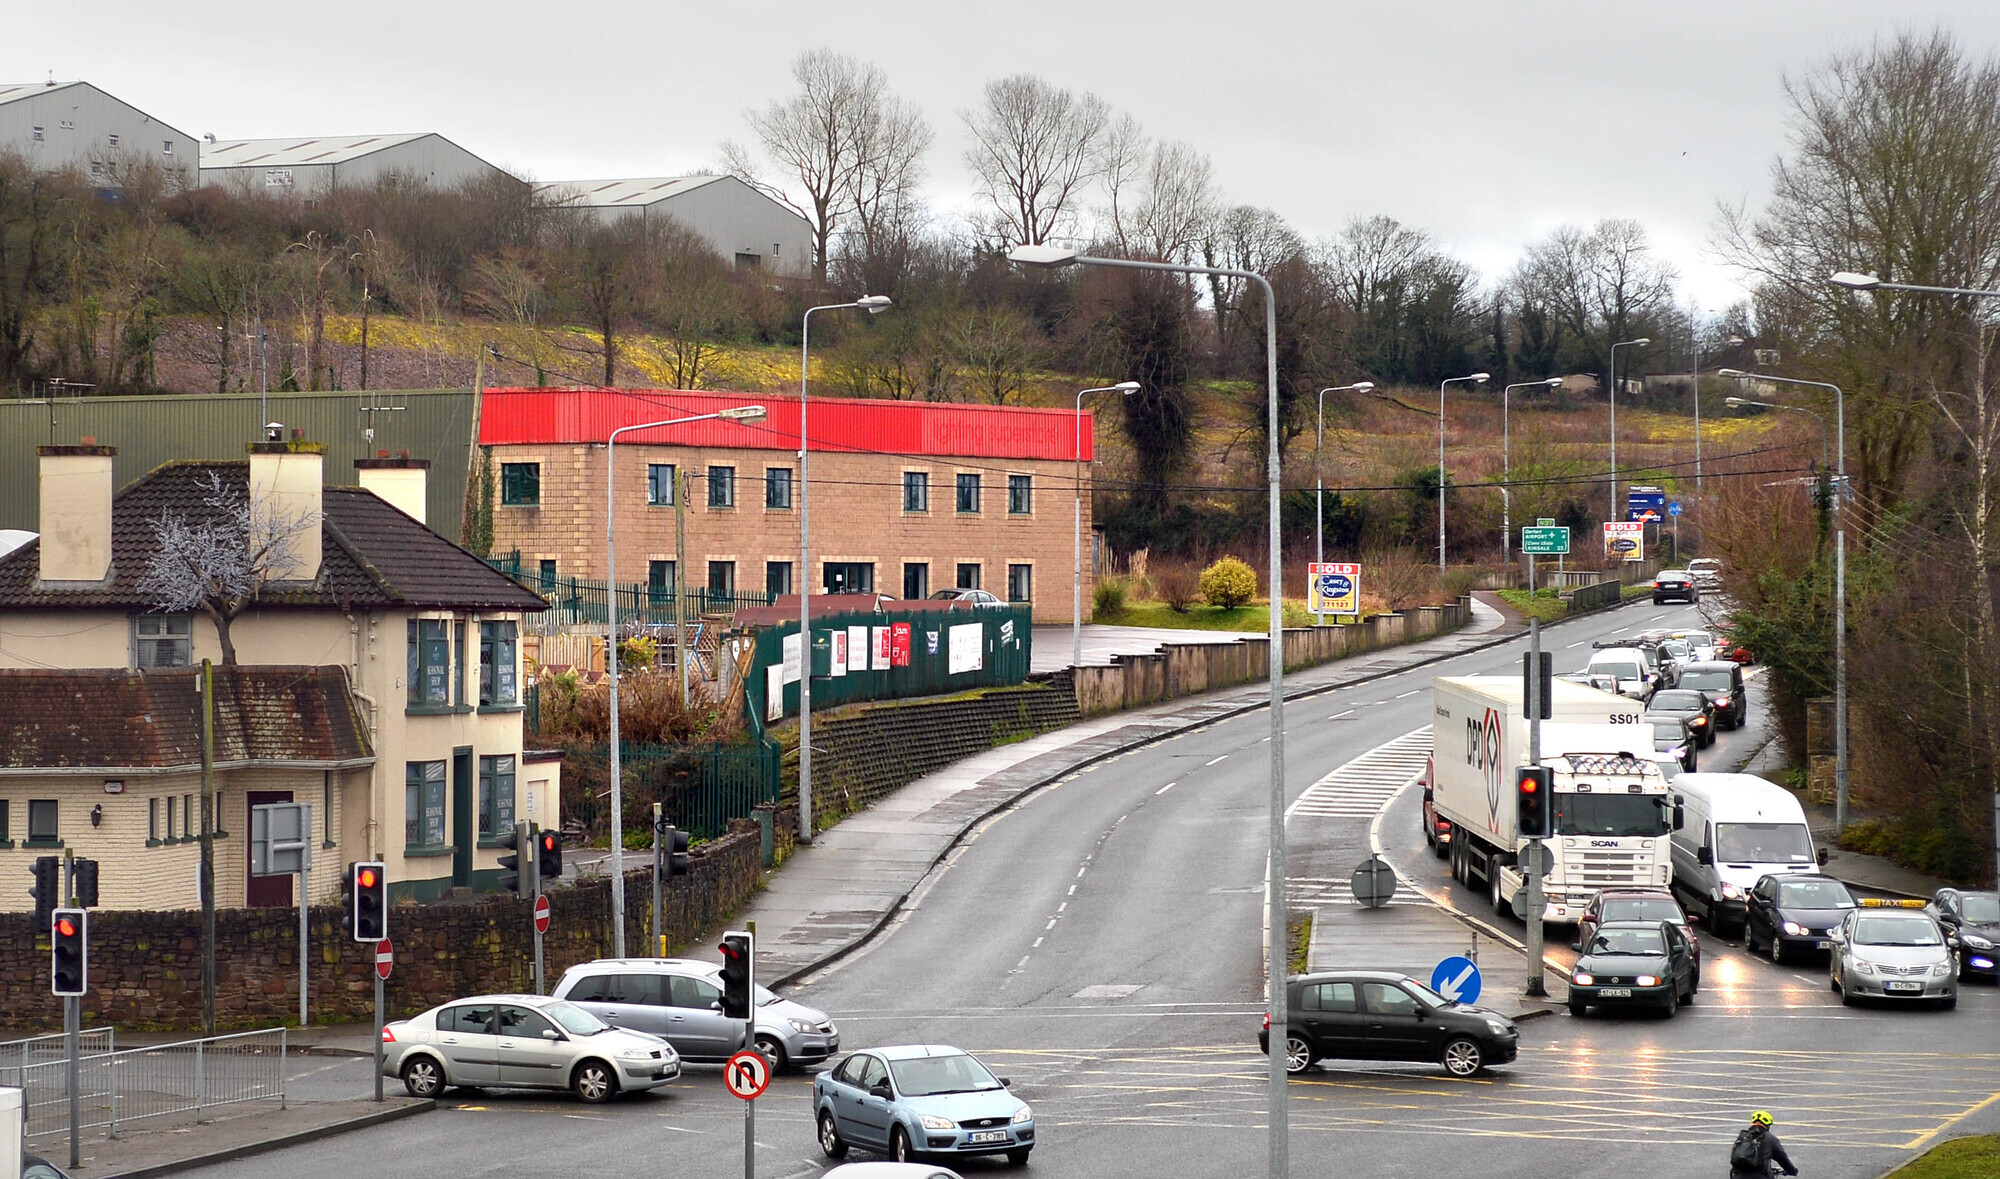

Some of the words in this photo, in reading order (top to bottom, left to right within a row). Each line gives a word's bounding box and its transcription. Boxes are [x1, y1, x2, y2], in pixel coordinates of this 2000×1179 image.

[1316, 565, 1352, 574] SOLD
[1609, 713, 1640, 725] SS01
[1467, 716, 1483, 770] DPD
[1880, 899, 1902, 907] TAXI
